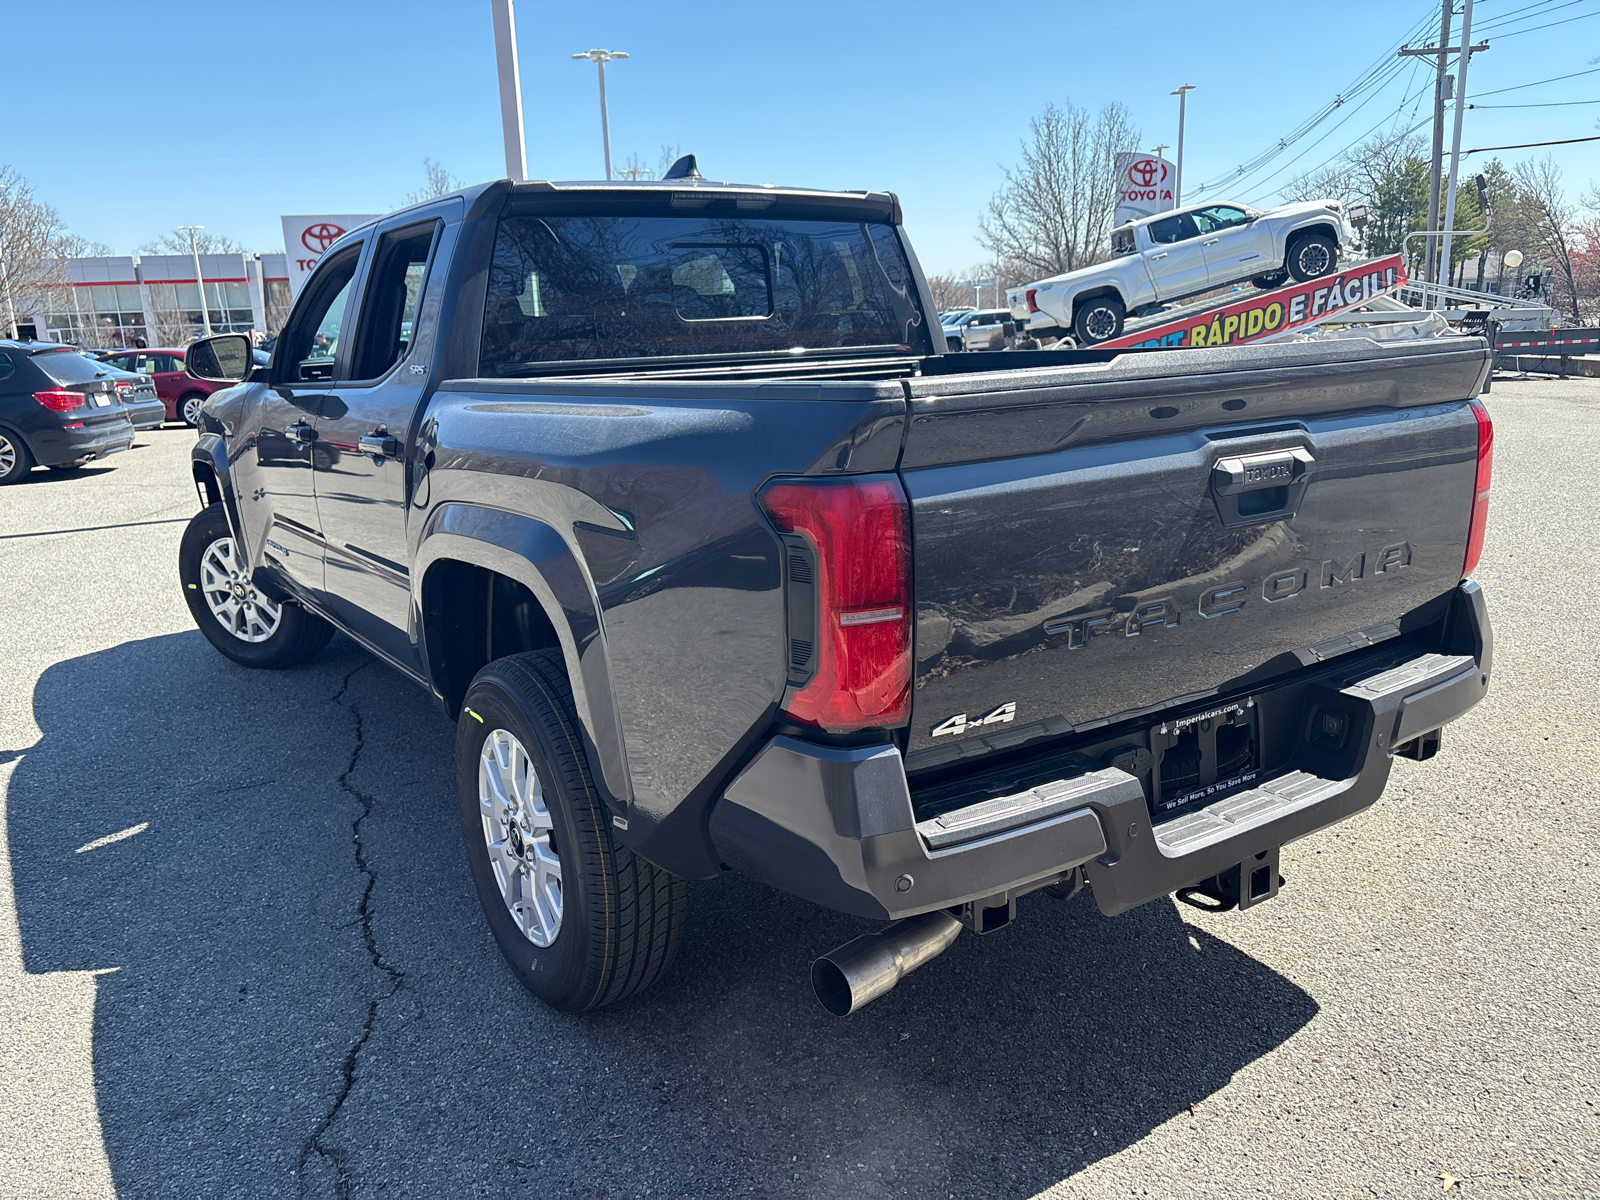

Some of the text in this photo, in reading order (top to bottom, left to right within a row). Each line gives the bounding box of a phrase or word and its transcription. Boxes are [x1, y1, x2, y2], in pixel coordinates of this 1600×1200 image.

[1120, 189, 1173, 201] TOYOTA
[1190, 302, 1284, 346] RÁPIDO
[1289, 293, 1308, 324] E
[1311, 266, 1396, 316] FÁCIL!
[1246, 464, 1291, 482] TOYOTA
[1043, 540, 1413, 650] TACOMA
[1175, 703, 1239, 728] Imperialcars.com
[1166, 773, 1257, 810] We Sell More, So You Save More
